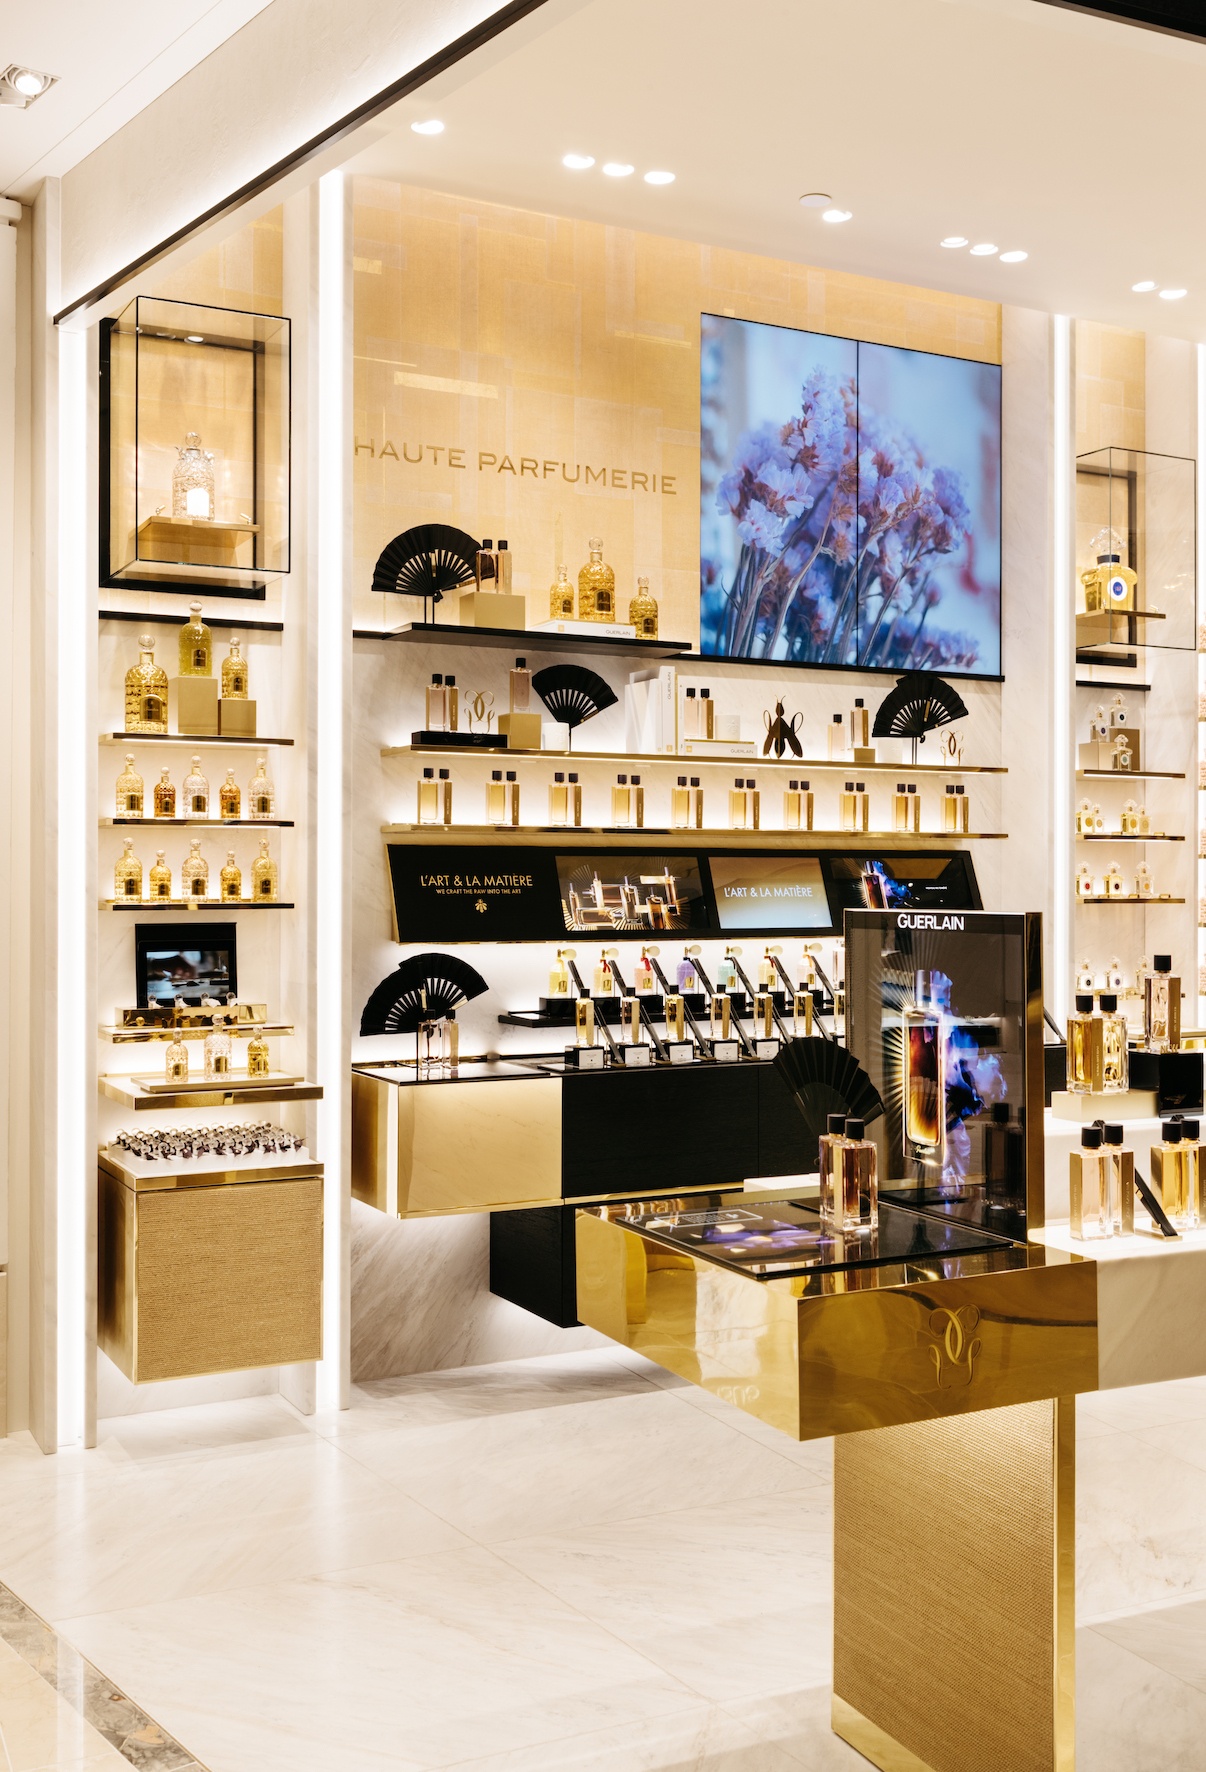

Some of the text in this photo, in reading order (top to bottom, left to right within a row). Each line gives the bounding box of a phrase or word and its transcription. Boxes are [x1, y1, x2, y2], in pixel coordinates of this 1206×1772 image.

[354, 435, 678, 495] HAUTE PARFUMERIE
[420, 873, 533, 887] L'ART & LA MATIÈRE
[724, 885, 813, 897] L'ART & LA MATIÈRE
[897, 913, 965, 931] GUERLAIN
